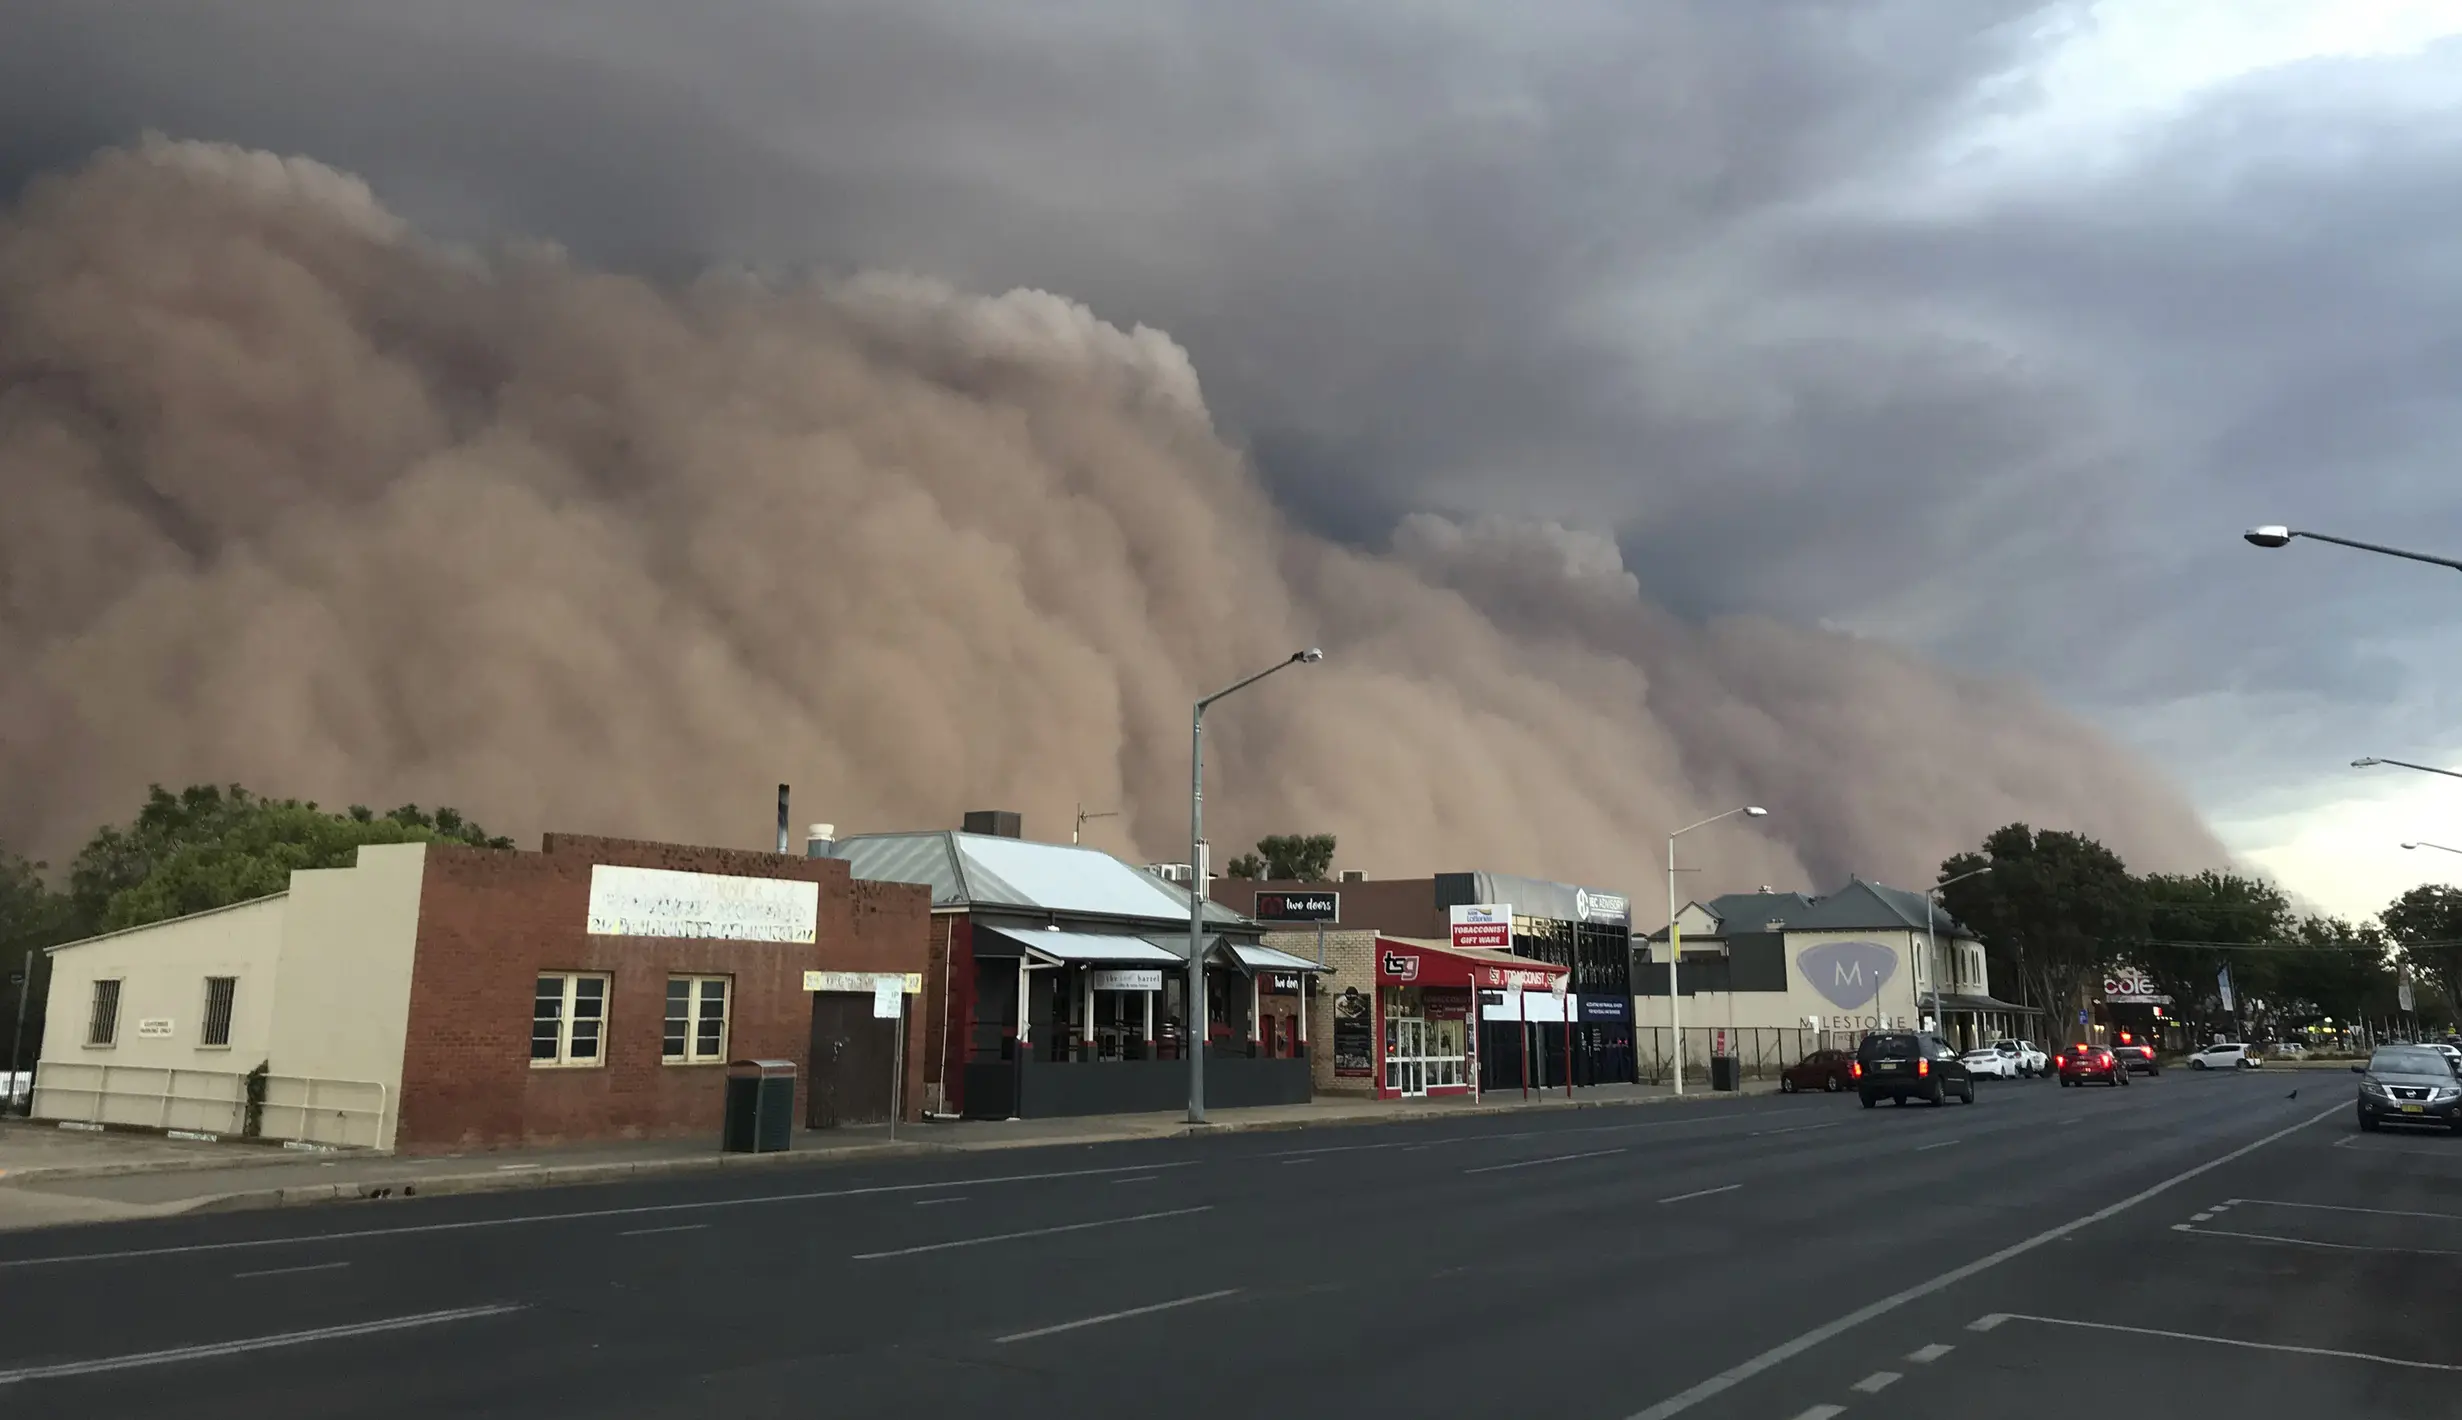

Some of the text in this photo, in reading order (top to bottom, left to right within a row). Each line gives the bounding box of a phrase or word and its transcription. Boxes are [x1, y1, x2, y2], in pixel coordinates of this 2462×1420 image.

[1286, 897, 1331, 911] two doors
[1454, 926, 1506, 934] TOBACCONIST
[1478, 936, 1500, 944] WARE
[1383, 951, 1419, 981] tsg
[1137, 974, 1160, 982] barrel
[1835, 960, 1862, 987] M
[1274, 974, 1285, 988] two
[2104, 968, 2155, 994] cole
[1800, 1016, 1907, 1028] MLESTONE
